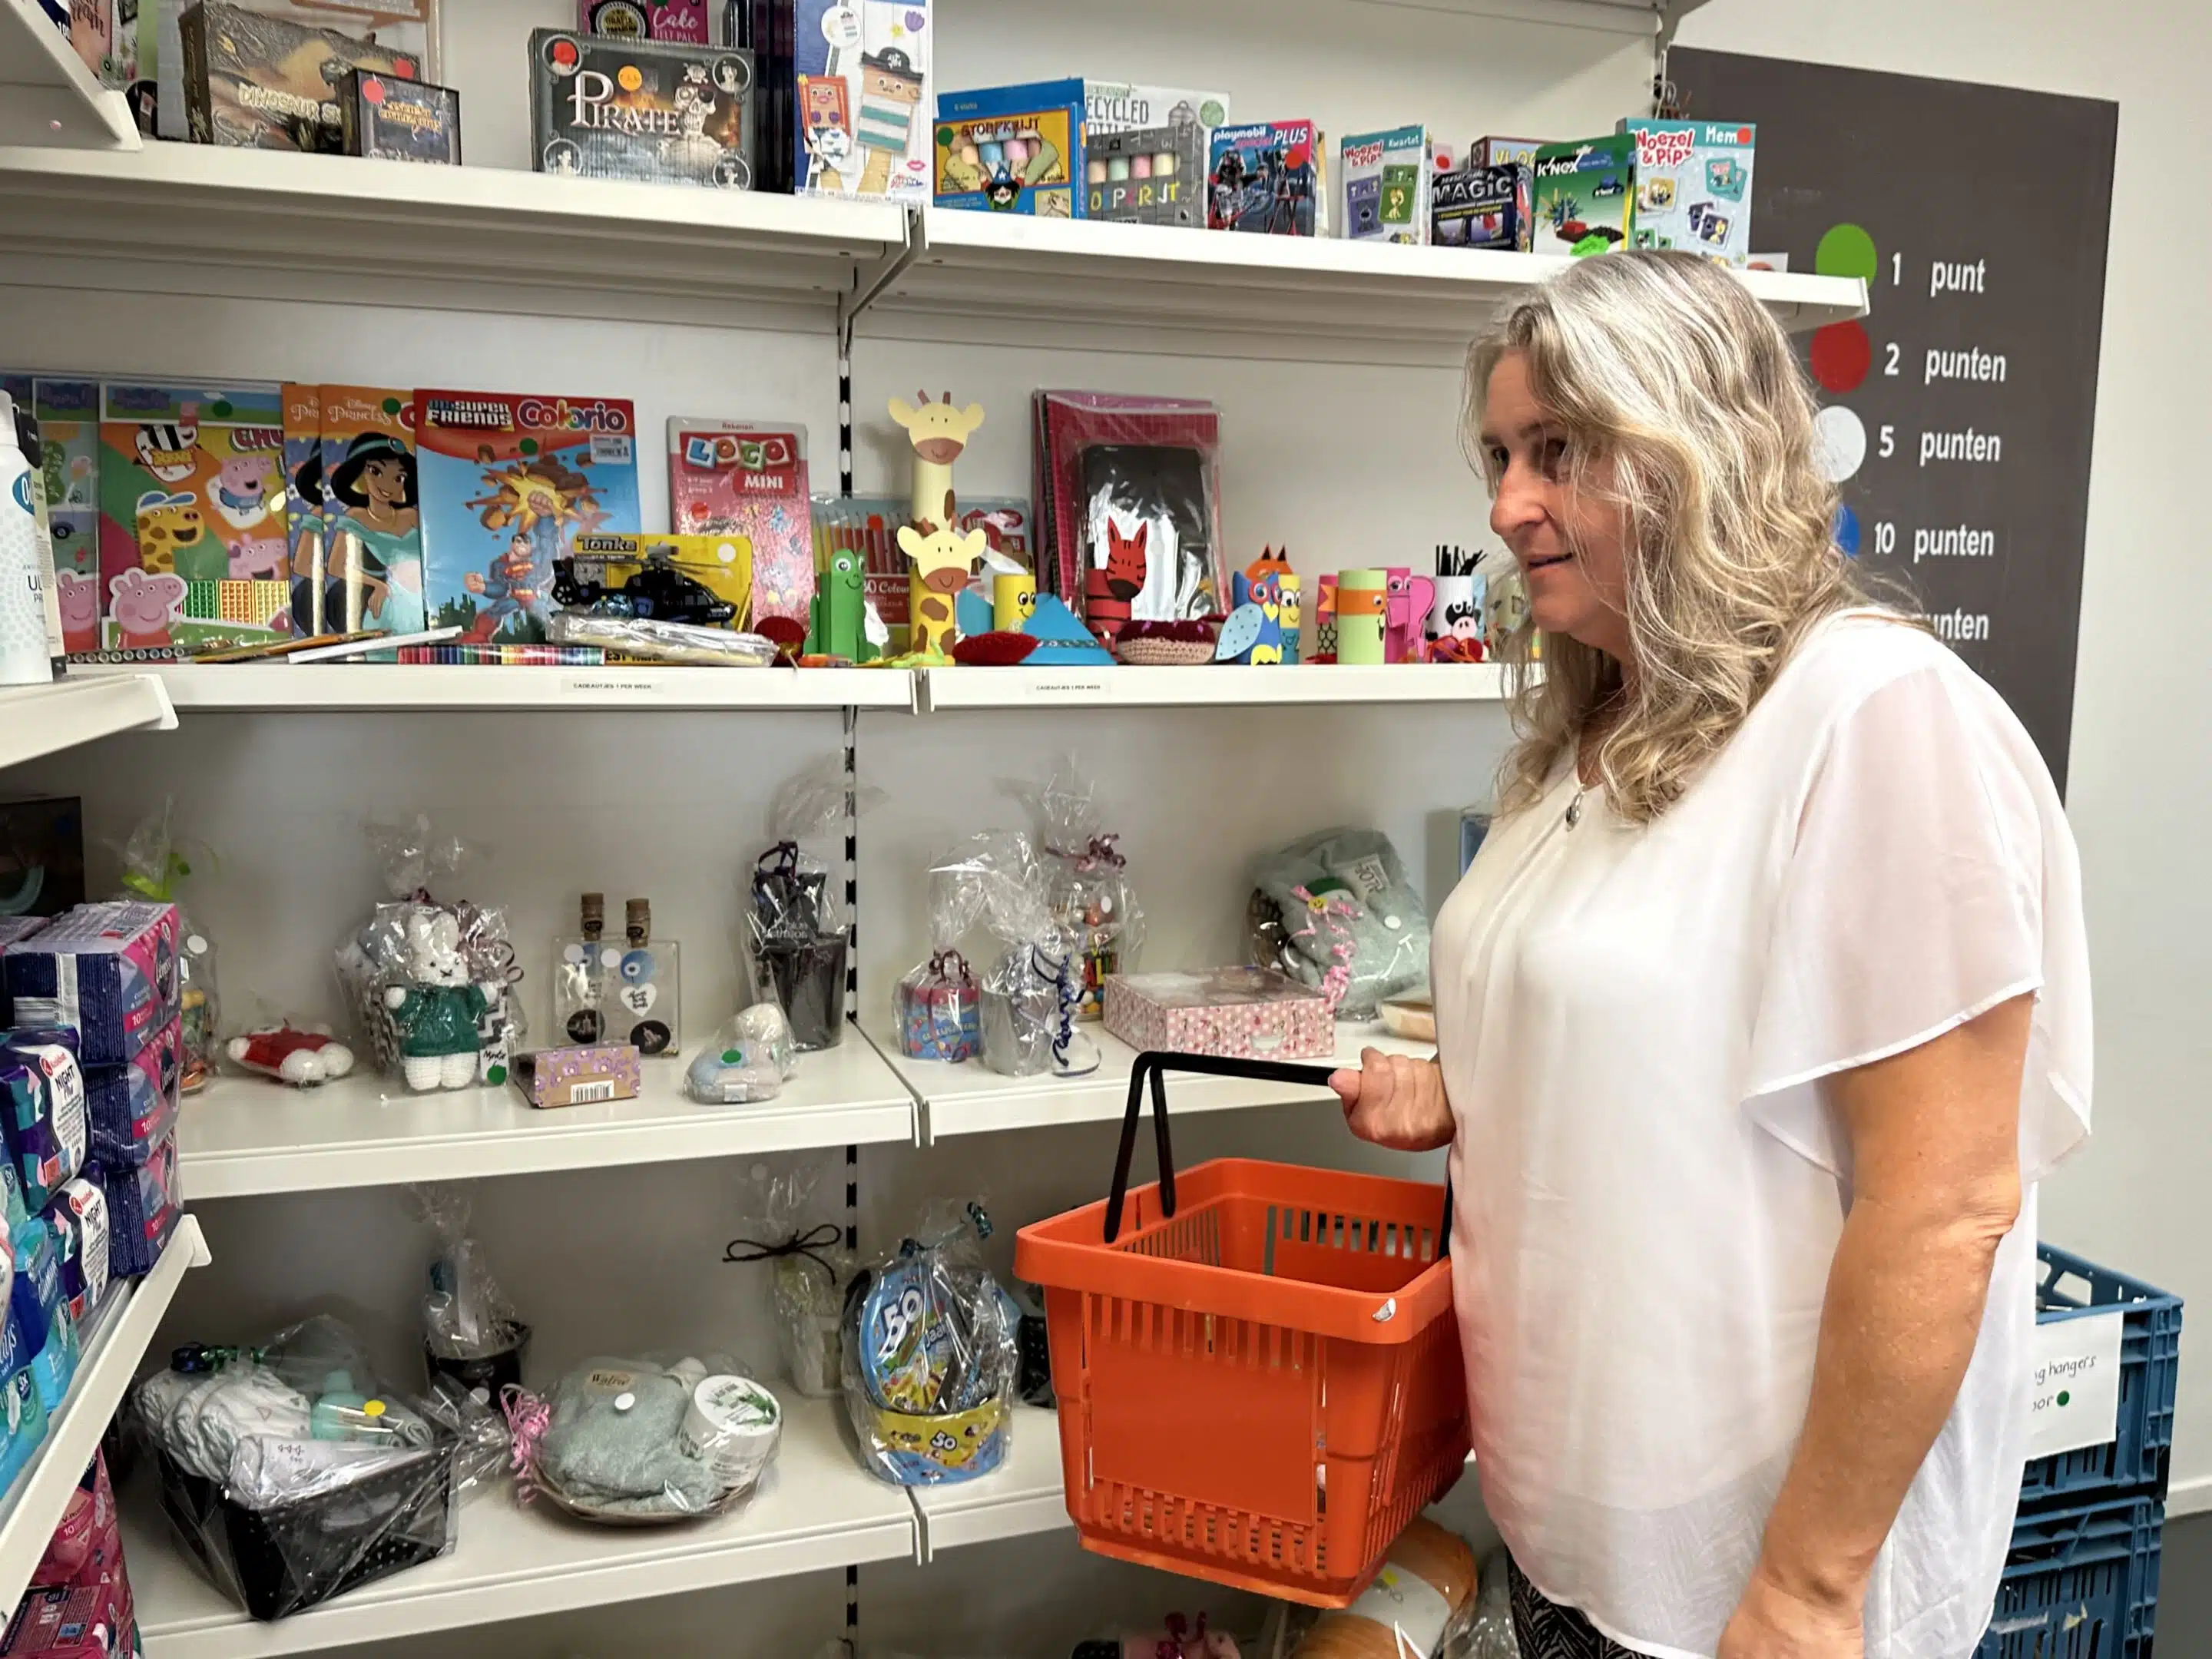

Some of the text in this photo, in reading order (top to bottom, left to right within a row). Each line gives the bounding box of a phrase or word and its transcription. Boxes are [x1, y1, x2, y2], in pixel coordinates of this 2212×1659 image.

[654, 7, 698, 28] Cake
[237, 82, 320, 123] DINOSAUR
[567, 70, 681, 137] PIRATE
[1214, 126, 1267, 142] playmobil
[1273, 127, 1308, 146] PLUS
[1388, 134, 1419, 148] Kwartet
[1345, 140, 1384, 160] Woezel
[1352, 154, 1378, 167] & Pip
[1642, 148, 1684, 165] & Pip
[1893, 253, 1985, 296] 1 punt
[1885, 343, 2005, 384] 2 punten
[326, 404, 392, 426] PRINCESS
[453, 400, 510, 413] SUPER
[518, 399, 628, 432] Colorio
[722, 422, 754, 431] Rekenen
[690, 438, 786, 464] LOCO
[1879, 426, 2000, 466] 5 punten
[744, 474, 783, 489] MINI
[577, 536, 637, 551] Tonka
[1875, 522, 1994, 563] 10 punten
[132, 1012, 141, 1026] 10
[55, 1065, 75, 1091] NIGHT
[84, 1200, 103, 1227] NIGHT
[882, 1287, 923, 1351] 50
[2048, 1355, 2097, 1378] hangers
[930, 1430, 958, 1450] 50
[64, 1525, 74, 1535] 10
